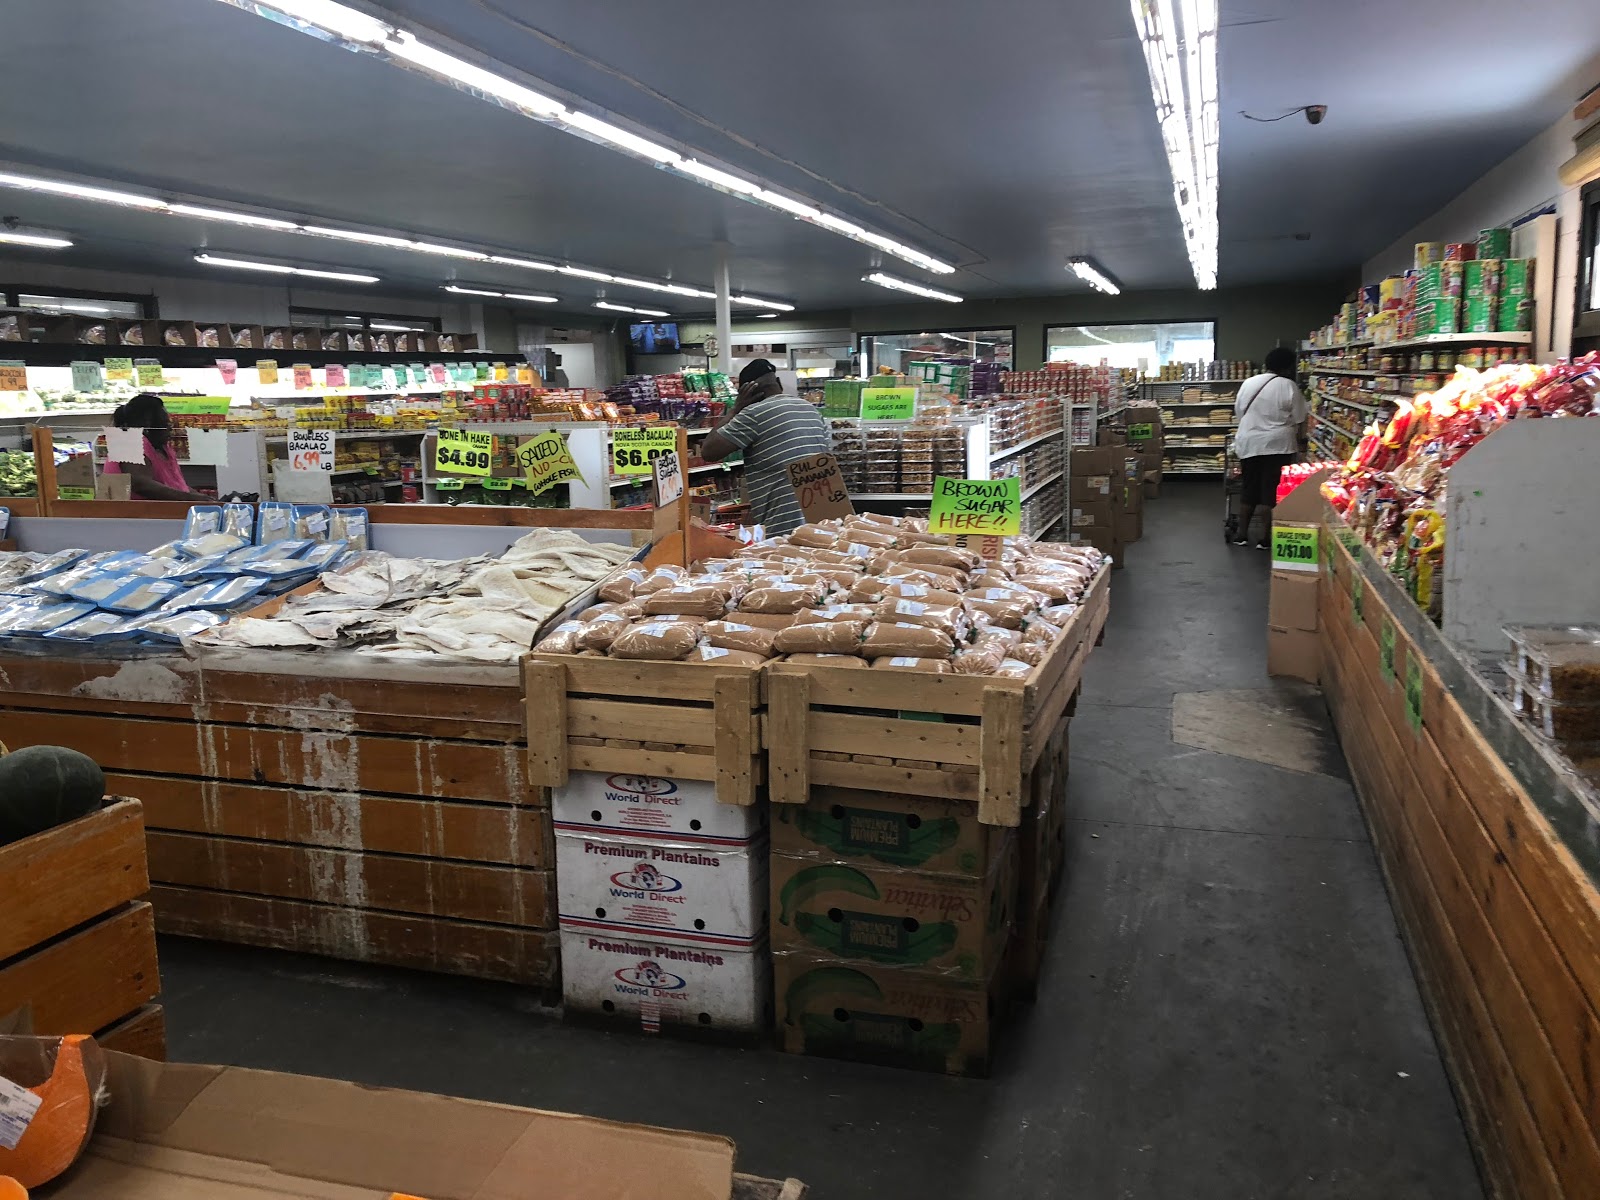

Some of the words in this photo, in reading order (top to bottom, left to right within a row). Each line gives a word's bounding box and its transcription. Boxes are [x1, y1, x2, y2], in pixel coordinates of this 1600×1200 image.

[293, 431, 329, 441] BONELESS
[438, 430, 459, 441] BONE
[460, 431, 469, 442] IN
[470, 434, 490, 445] HAKE
[614, 431, 645, 442] BONELESS
[646, 430, 674, 441] BACALAO
[289, 442, 327, 451] BACALAO
[520, 440, 559, 468] SALTED
[294, 451, 319, 470] 6.99
[320, 462, 332, 470] LB
[438, 447, 489, 469] $4.99
[790, 456, 829, 478] RULO
[533, 472, 558, 492] WHOLE
[942, 480, 1008, 498] BROWN
[954, 498, 1013, 514] SUGAR
[939, 512, 1008, 531] HERE!!
[605, 791, 639, 803] World
[644, 794, 681, 806] Direct
[584, 841, 647, 859] Premium
[651, 848, 720, 867] Plantains
[609, 887, 645, 900] World
[649, 891, 685, 904] Direct
[588, 938, 650, 957] Premium
[654, 945, 724, 966] Plantains
[614, 984, 648, 996] World
[653, 988, 688, 1000] Direct
